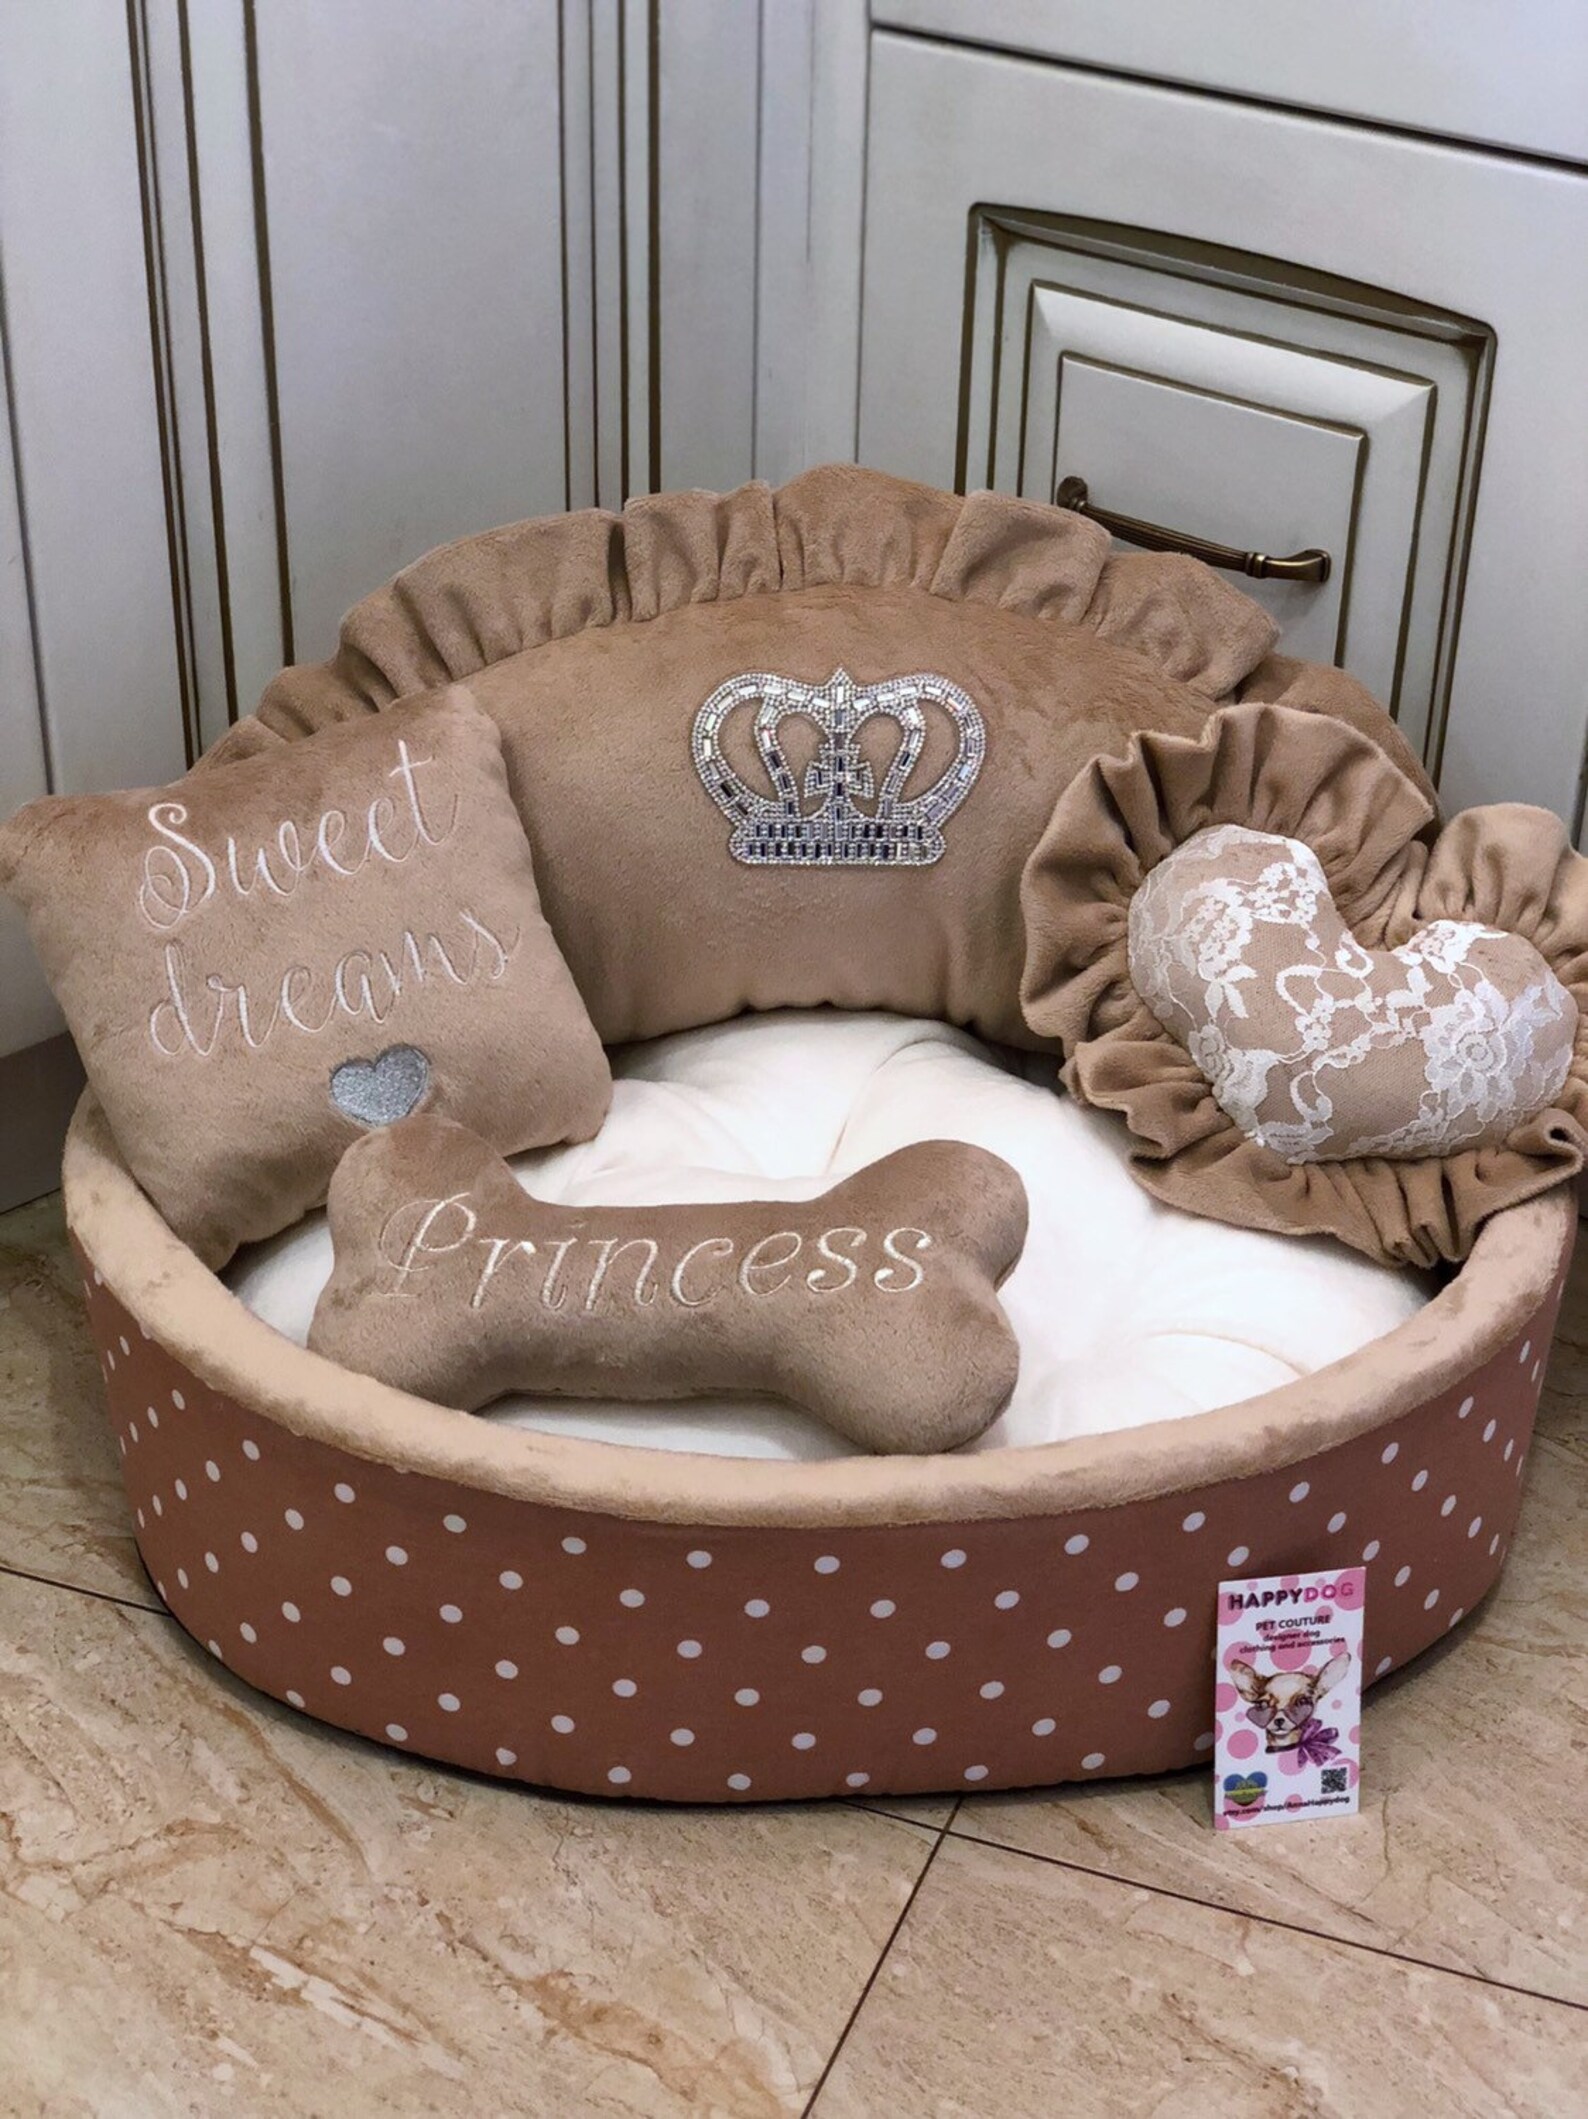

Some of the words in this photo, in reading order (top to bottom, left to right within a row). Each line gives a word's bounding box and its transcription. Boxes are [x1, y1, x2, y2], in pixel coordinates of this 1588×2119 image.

[139, 739, 459, 930] Sweet
[149, 909, 521, 1057] dreams
[379, 1192, 932, 1311] Princess
[1227, 1582, 1354, 1610] HAPPYDOG
[1255, 1620, 1276, 1632] PET
[1278, 1614, 1331, 1630] COUTURE
[1263, 1631, 1301, 1643] designer
[1303, 1629, 1321, 1641] dog
[1239, 1644, 1276, 1655] clothing
[1278, 1640, 1296, 1650] and
[1297, 1636, 1346, 1649] accessories
